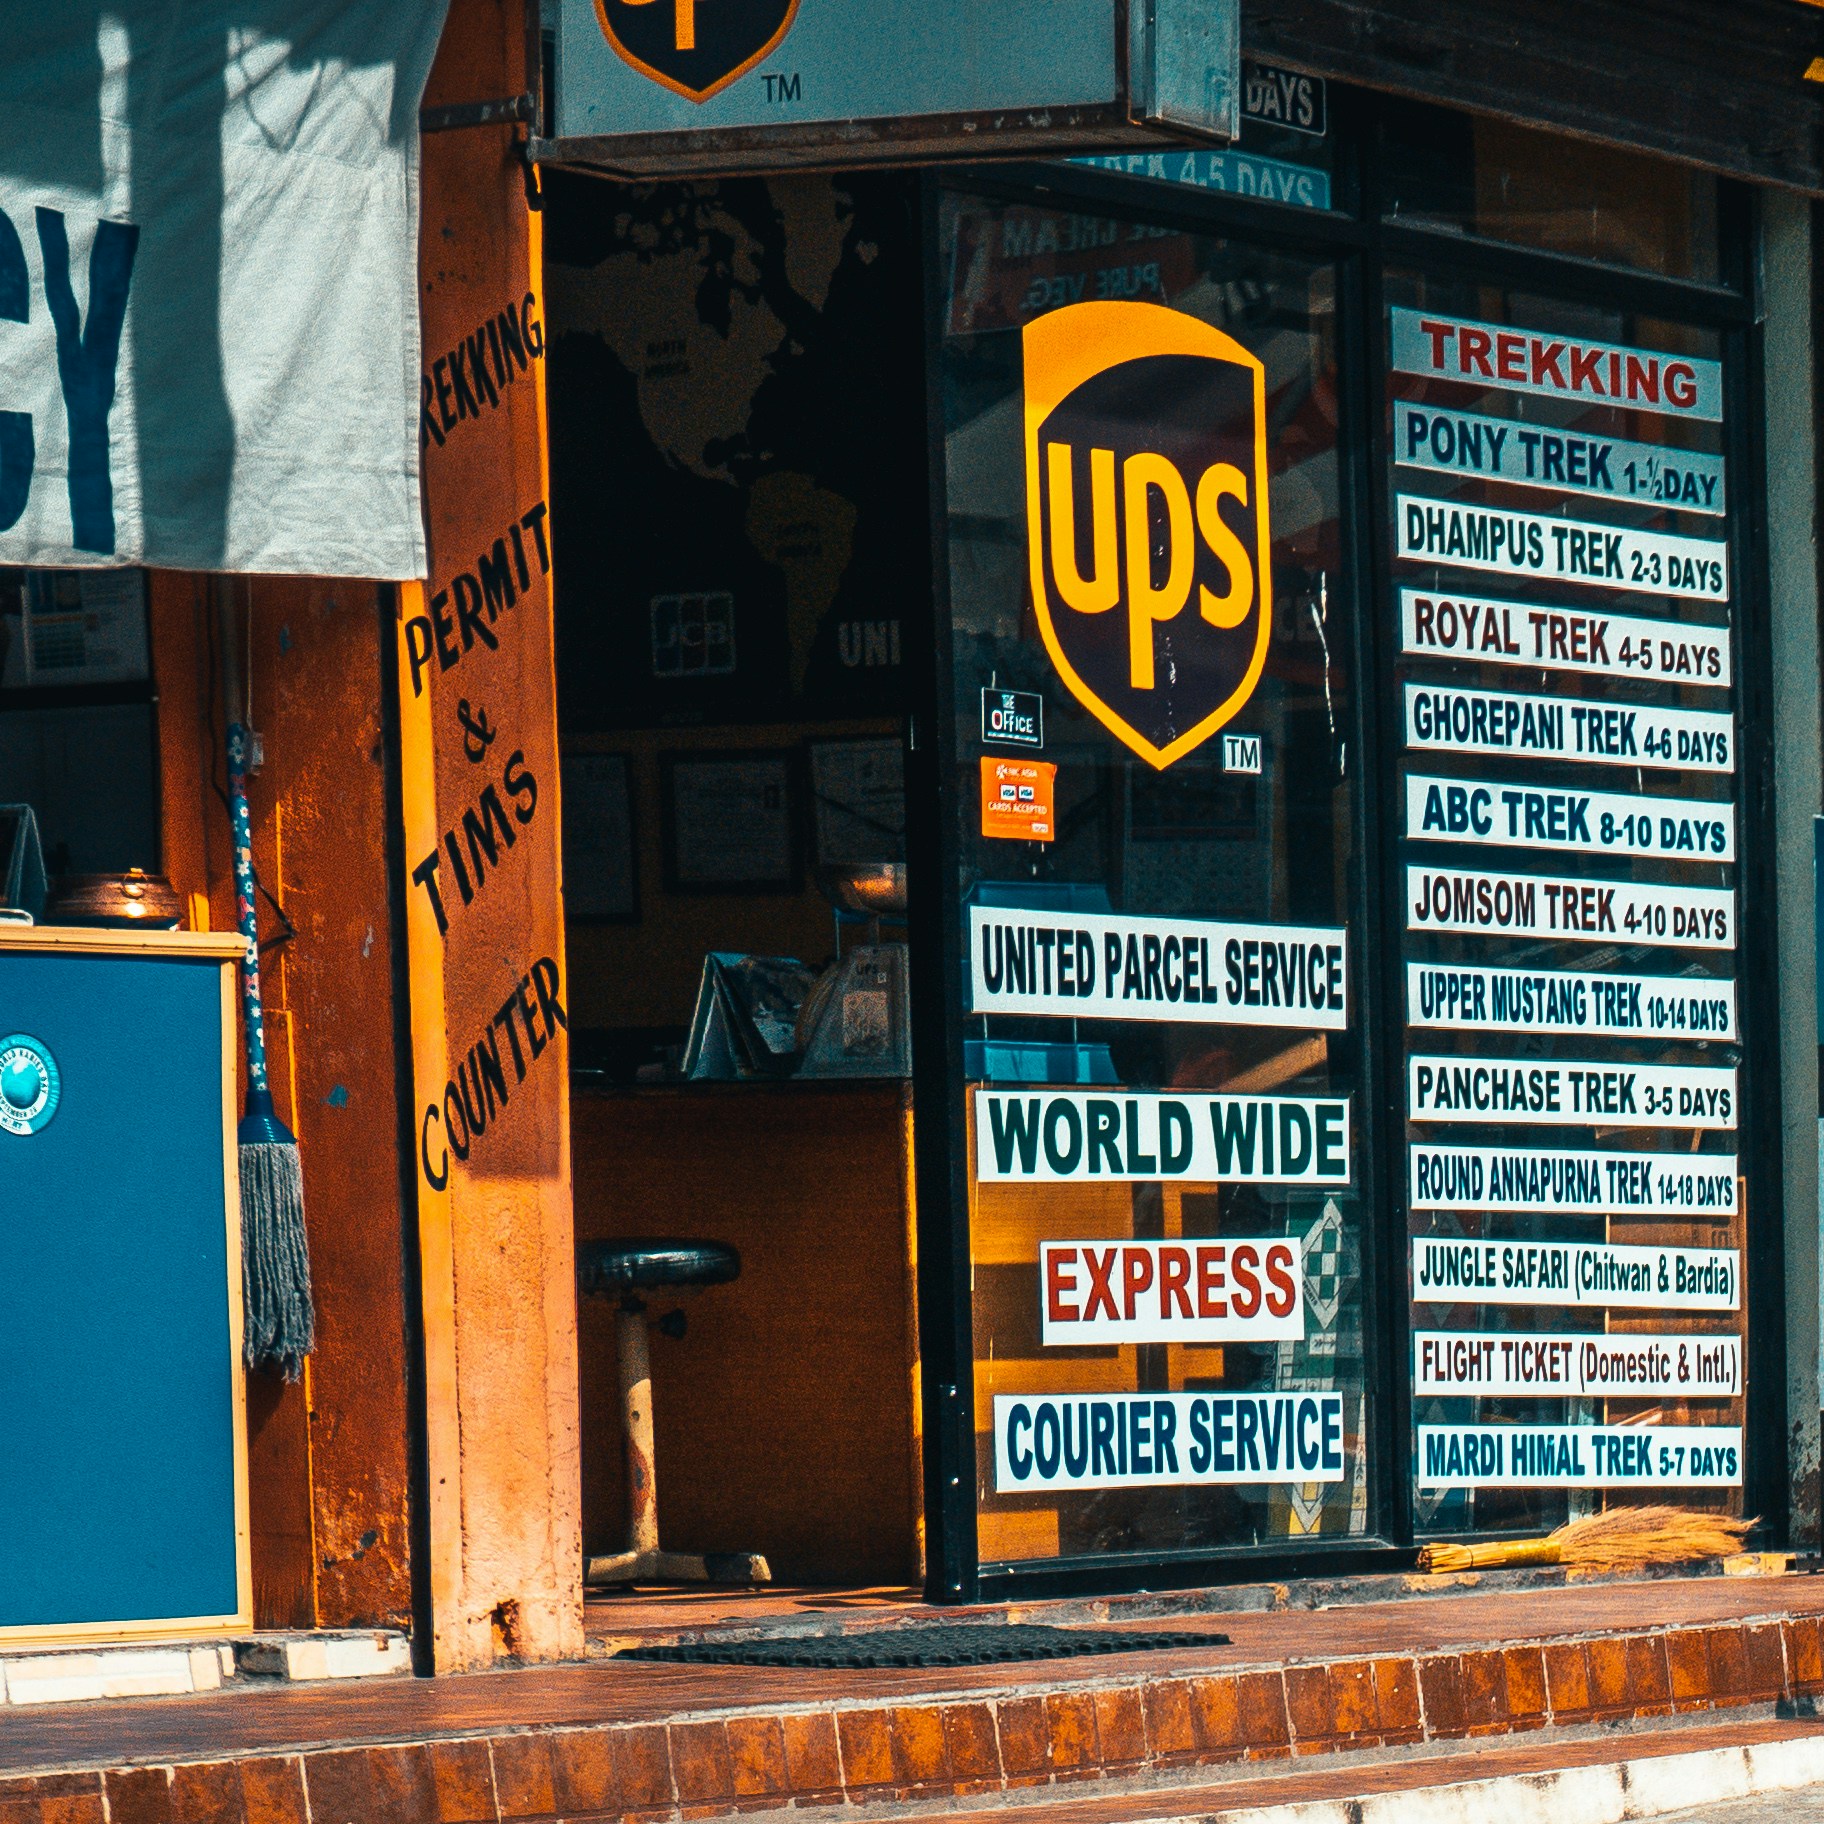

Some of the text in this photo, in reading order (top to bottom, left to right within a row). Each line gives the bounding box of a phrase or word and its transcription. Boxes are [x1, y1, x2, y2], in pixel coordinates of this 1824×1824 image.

[762, 75, 802, 103] TM
[1247, 69, 1314, 127] DAYS
[420, 292, 546, 449] REKKING
[1421, 321, 1697, 408] TREKKING
[1408, 411, 1508, 472] PONY
[1518, 431, 1613, 490] TREK
[1048, 442, 1254, 690] ups
[1407, 503, 1722, 593] DHAMPUS TREK 2-3 DAYS
[403, 501, 551, 698] PERMIT
[1415, 598, 1720, 678] ROYAL TREK 4-5 DAYS
[457, 699, 497, 763] &
[1226, 738, 1260, 766] TM
[1414, 692, 1727, 764] GHOREPANI TREK 4-6 DAYS
[412, 750, 538, 937] TIMS
[1422, 784, 1726, 852] ABC TREK 8-10 DAYS
[1415, 875, 1726, 940] JOMSOM TREK 4-10 DAYS
[981, 923, 1343, 1010] UNITED PARCEL SERVICE
[1419, 971, 1728, 1032] UPPER MUSTANG TREK 10-14 DAYS
[420, 957, 569, 1192] COUNTER
[1417, 1066, 1731, 1119] PANCHASE TREK 3-5 DAYS
[988, 1098, 1346, 1176] WORLD WIDE
[1417, 1154, 1732, 1207] ROUND ANNAPURNA TREK 14-18 DAYS
[1047, 1245, 1294, 1323] EXPRESS
[1420, 1246, 1734, 1305] JUNGLE SAFARI (Chitwan & Bardia)
[1422, 1341, 1736, 1392] FLIGHT TICKET (Domestic & Intl.)
[1007, 1398, 1342, 1480] COURIER SERVICE
[1426, 1434, 1737, 1476] MARDI HIMAL TREK 5-7 DAYS
